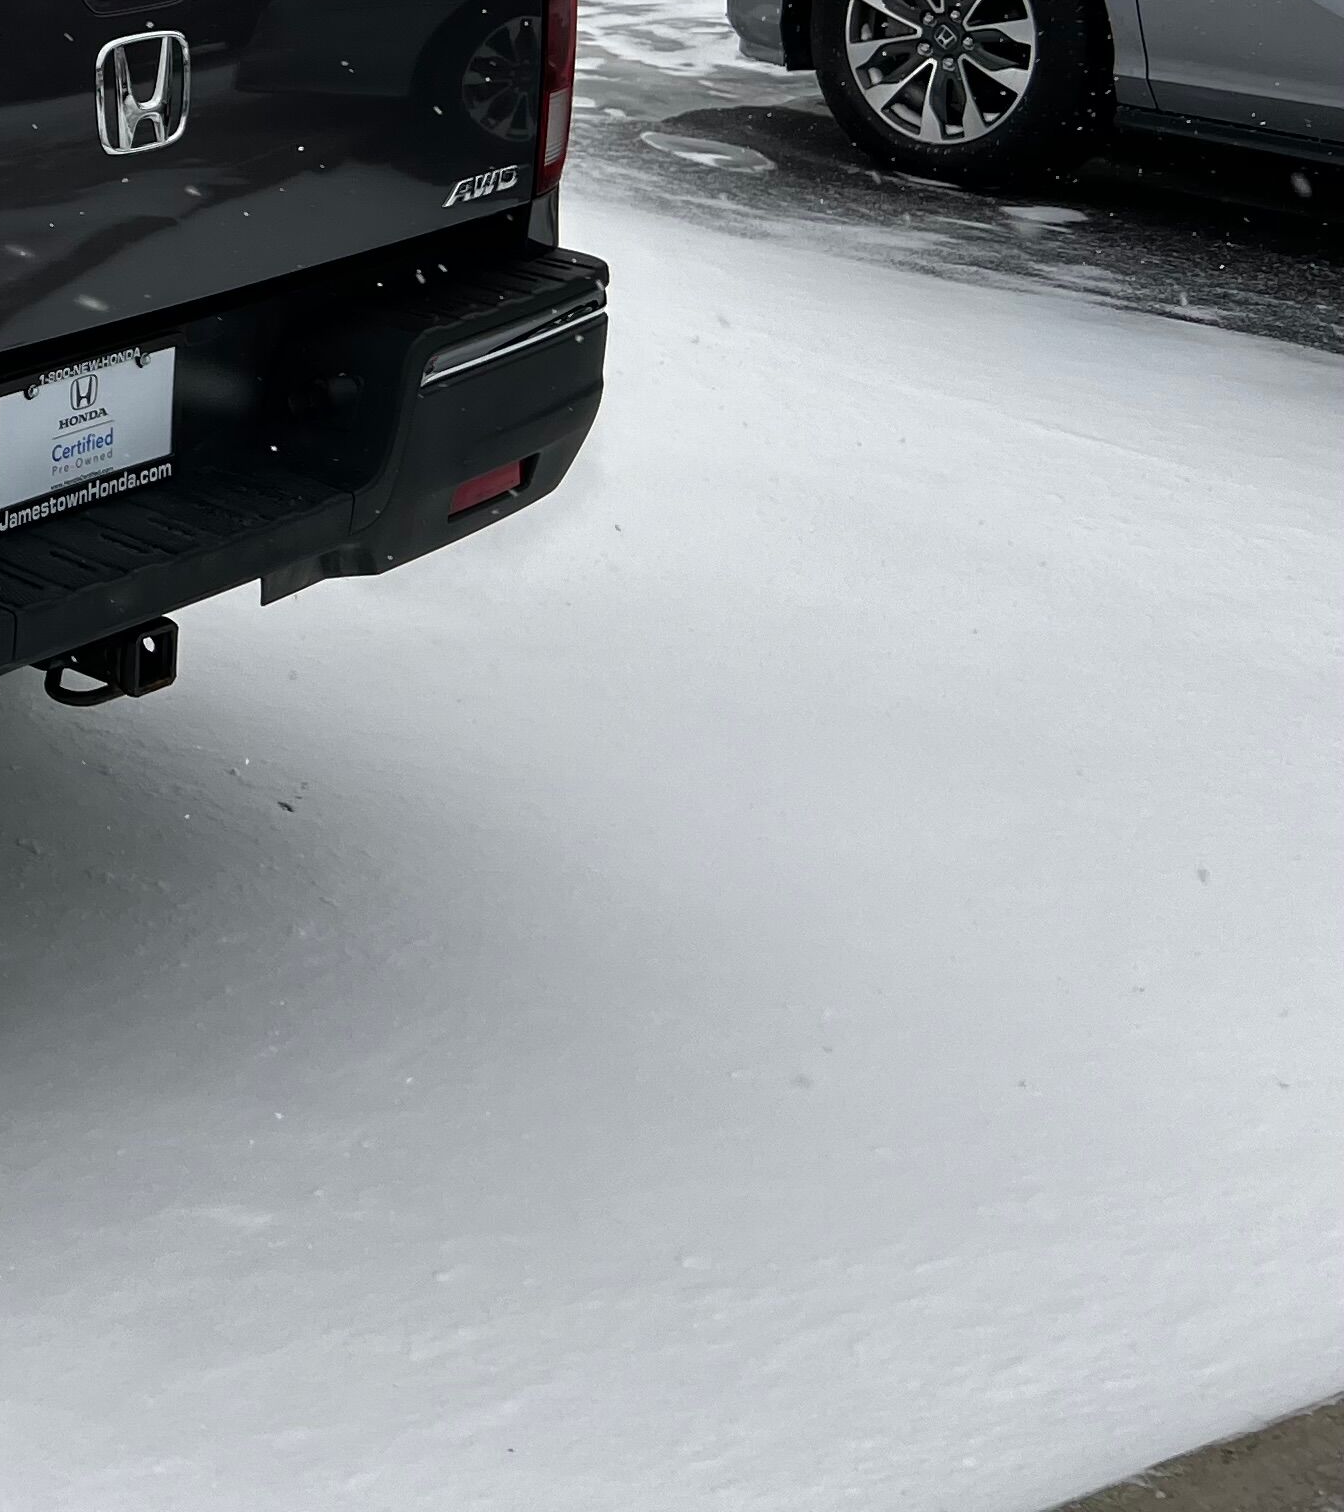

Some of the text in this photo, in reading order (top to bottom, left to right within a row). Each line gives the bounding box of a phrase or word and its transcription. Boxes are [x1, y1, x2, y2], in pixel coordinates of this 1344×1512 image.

[442, 165, 518, 207] AWD
[38, 347, 141, 385] 1-800-NEW-HONDA
[58, 407, 108, 430] HONDA
[52, 427, 113, 462] Certified
[0, 463, 172, 532] JamestownHonda.com
